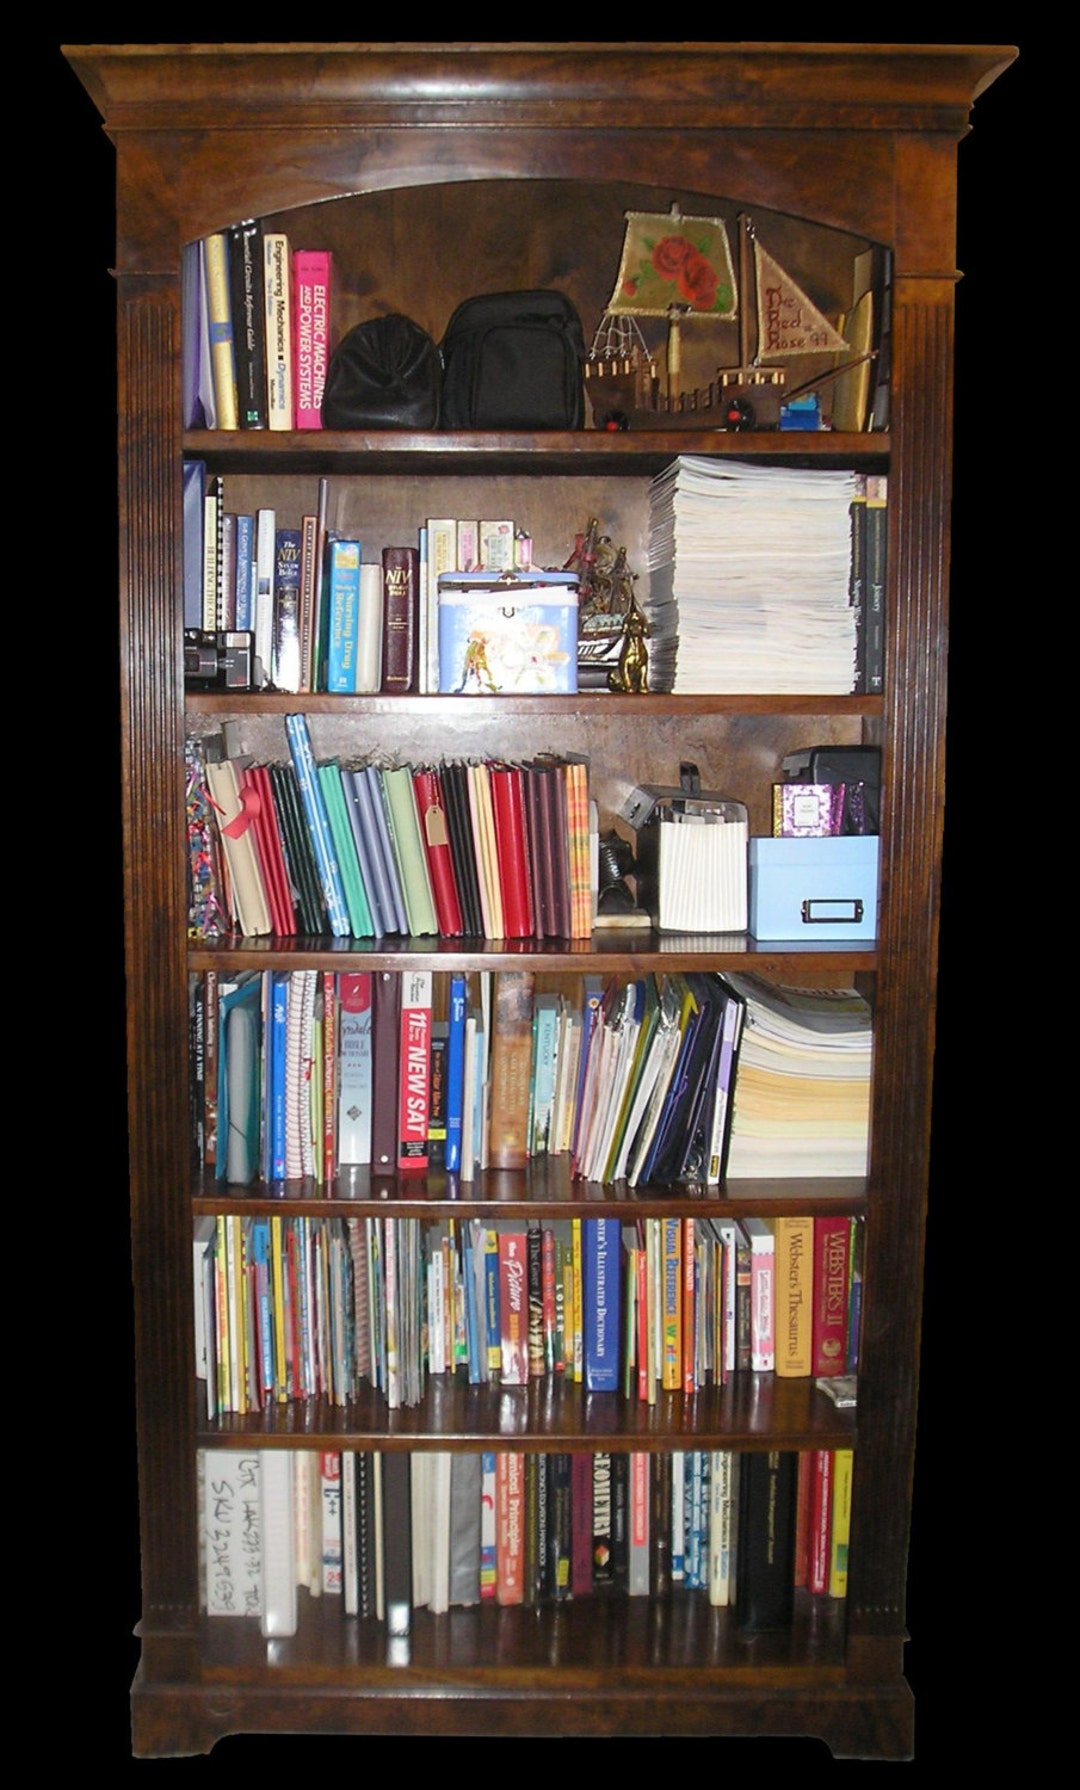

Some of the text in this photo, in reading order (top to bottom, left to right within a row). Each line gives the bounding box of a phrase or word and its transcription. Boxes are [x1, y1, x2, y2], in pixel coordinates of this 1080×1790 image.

[244, 265, 253, 293] Circuits
[302, 284, 312, 305] AND
[244, 294, 254, 327] Reference
[273, 240, 287, 410] Engineering Mechanics Dynamics
[767, 308, 802, 330] Red
[245, 328, 255, 352] Guide
[299, 305, 311, 354] POWER
[313, 284, 326, 410] ELECTRIC MACHINES
[766, 332, 806, 350] Rose
[299, 354, 311, 410] SYSTEMS
[239, 535, 248, 558] GOSPEL
[277, 549, 300, 561] NIV
[283, 541, 296, 549] The
[385, 569, 412, 584] NIV
[343, 593, 355, 637] Nursing
[871, 584, 882, 612] Joinery
[341, 640, 354, 670] Drug
[196, 1001, 203, 1012] AN
[206, 971, 215, 1005] Christmas
[408, 1012, 427, 1027] 11
[196, 1044, 203, 1055] AT
[543, 1022, 551, 1067] KENTUCKY
[407, 1046, 426, 1095] NEW
[406, 1097, 425, 1137] SAT
[508, 1241, 517, 1257] the
[530, 1242, 540, 1262] The
[597, 1219, 607, 1250] STER'S
[665, 1219, 680, 1254] VISUAL
[596, 1251, 607, 1306] ILLUSTRATED
[787, 1232, 803, 1288] Webster's
[503, 1260, 524, 1311] Picture
[665, 1258, 680, 1315] REFERENCE
[825, 1230, 846, 1328] WEBSTER'S II
[555, 1283, 564, 1333] LOSER
[788, 1291, 803, 1357] Thesaurus
[596, 1308, 607, 1358] DICTIONARY
[720, 1452, 729, 1498] Engineering
[211, 1480, 234, 1523] SKU
[507, 1453, 520, 1556] emical Principles
[721, 1499, 730, 1543] Mechanics
